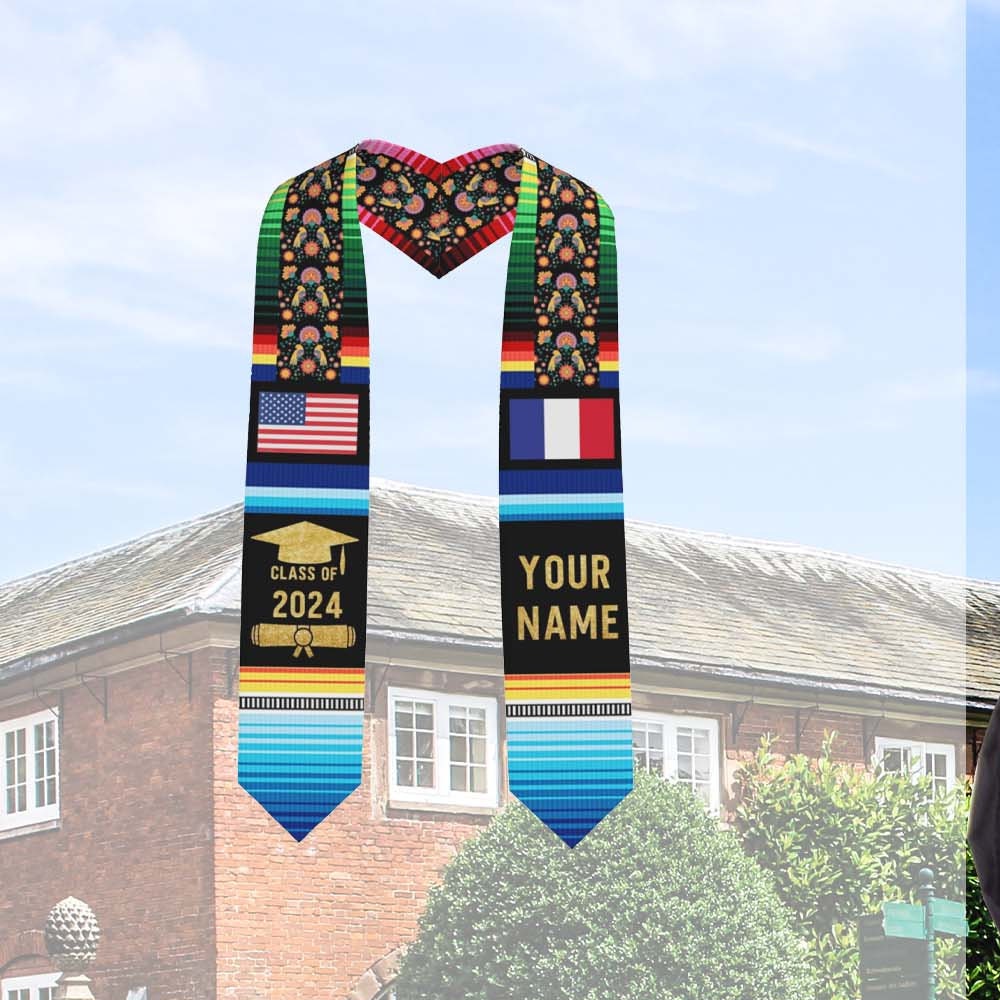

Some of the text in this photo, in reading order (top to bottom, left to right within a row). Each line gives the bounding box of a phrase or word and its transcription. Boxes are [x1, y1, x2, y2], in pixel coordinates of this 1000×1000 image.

[270, 565, 338, 582] CLASS OF
[518, 554, 611, 590] YOUR
[272, 589, 343, 619] 2024
[517, 604, 619, 641] NAME
